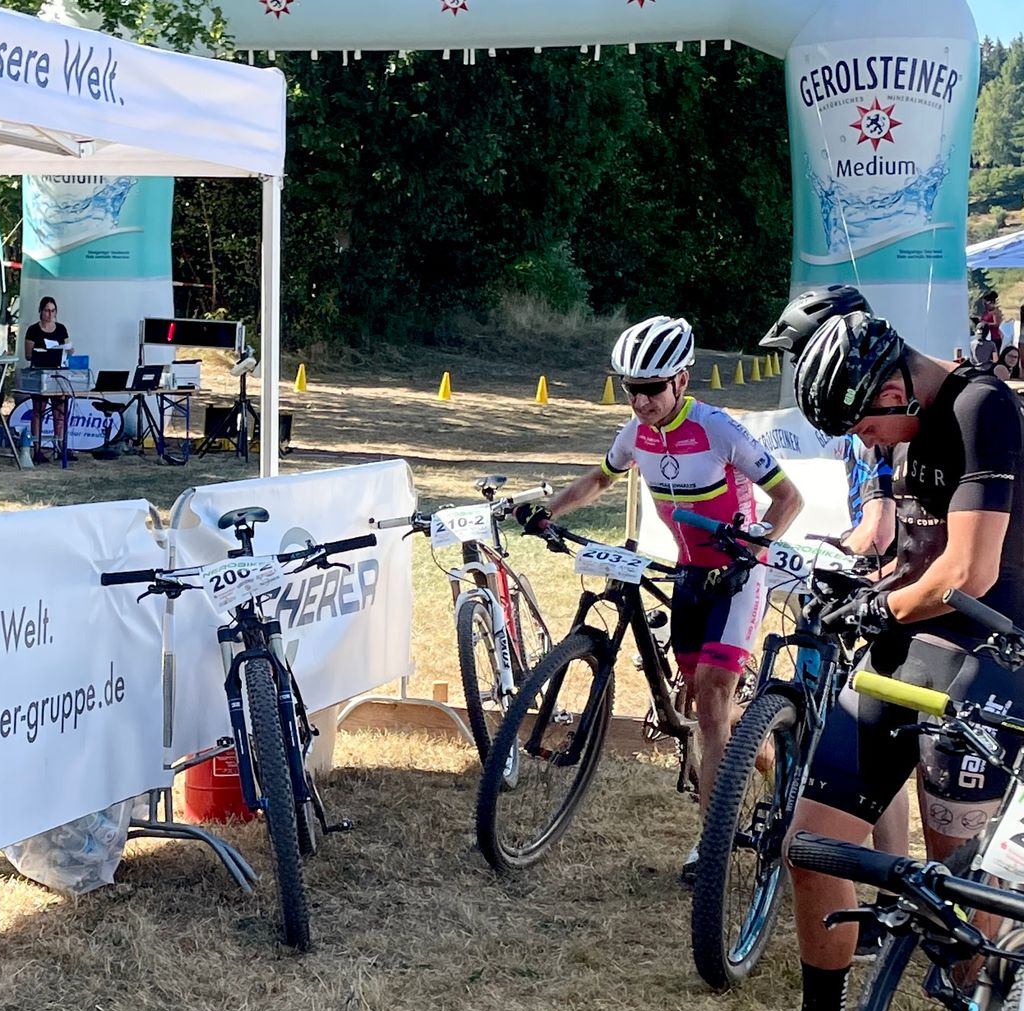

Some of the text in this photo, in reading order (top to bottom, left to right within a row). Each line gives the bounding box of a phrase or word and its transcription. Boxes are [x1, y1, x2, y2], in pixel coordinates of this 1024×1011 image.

[64, 39, 125, 106] Welt.
[799, 55, 959, 107] GEROLSTEINER
[836, 155, 916, 178] Medium
[436, 515, 485, 533] 210-2
[582, 550, 642, 567] 203-2
[0, 598, 54, 653] Welt.
